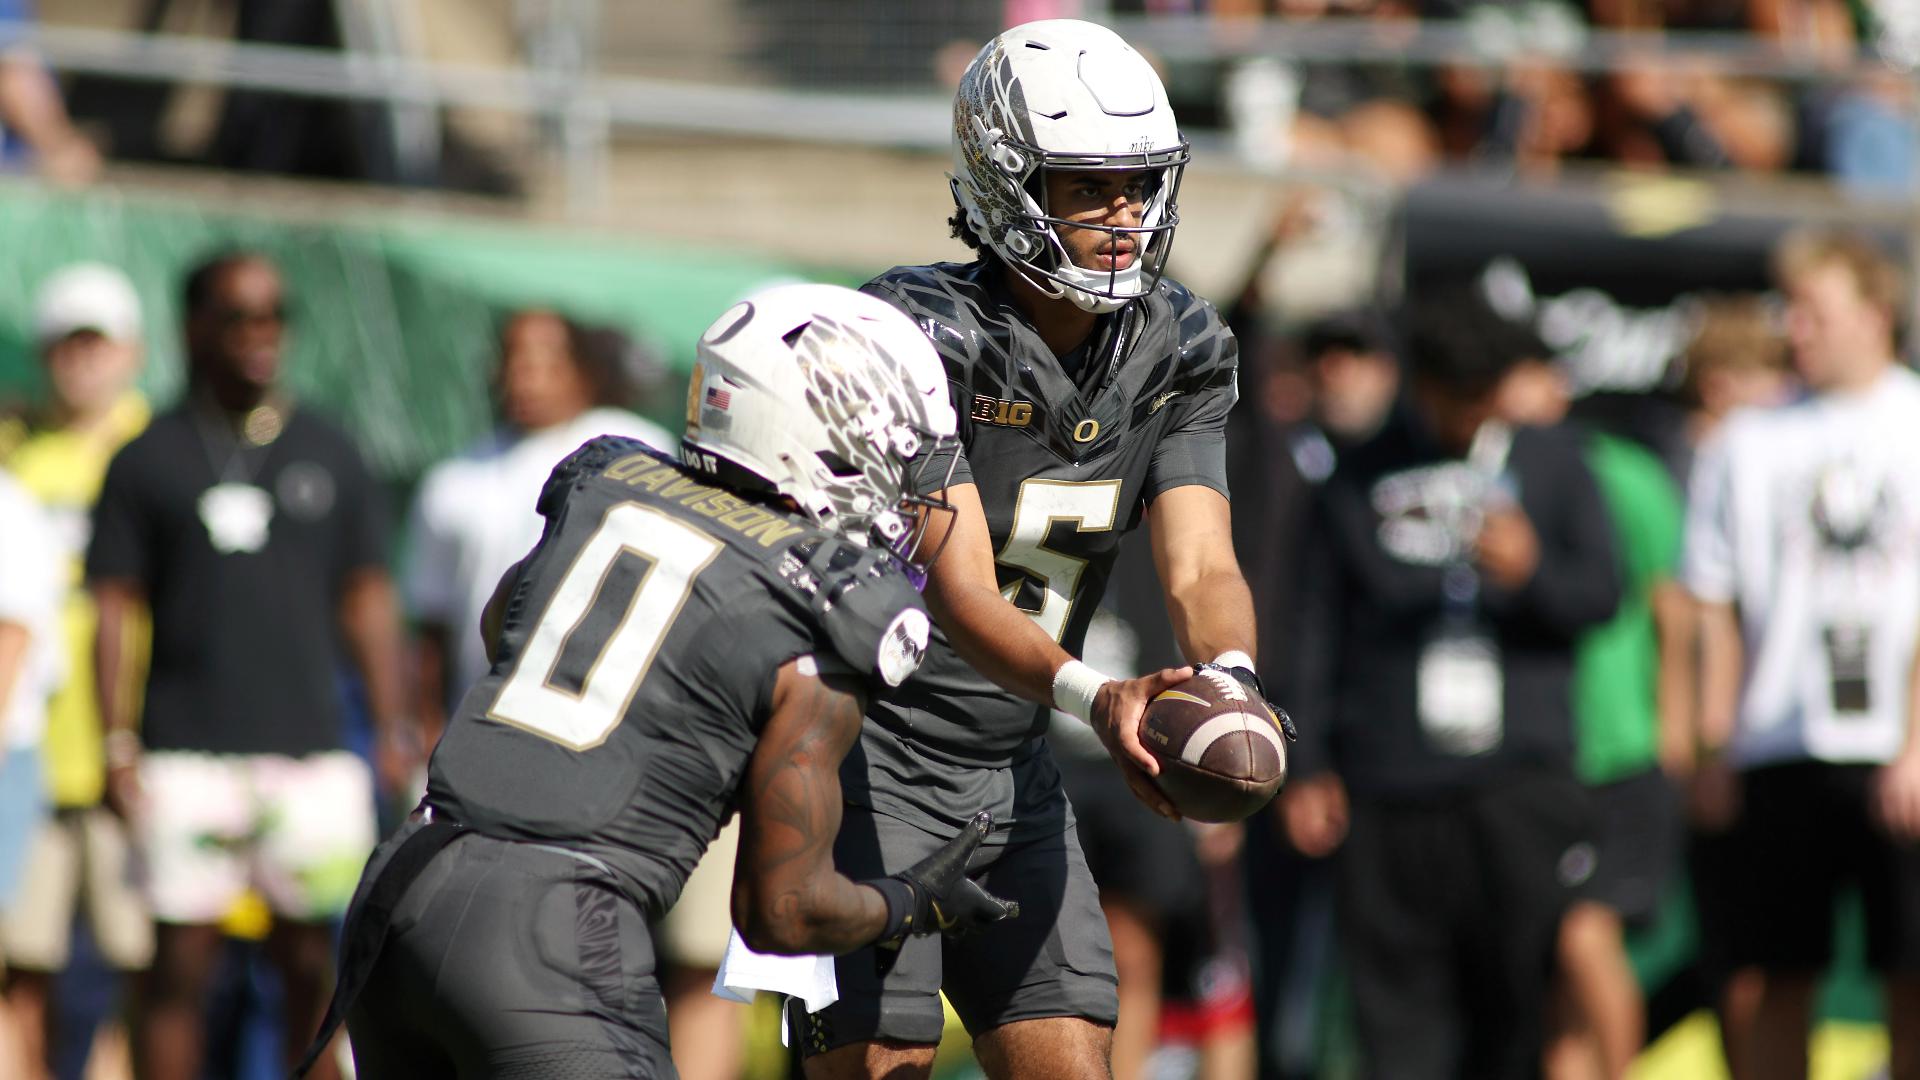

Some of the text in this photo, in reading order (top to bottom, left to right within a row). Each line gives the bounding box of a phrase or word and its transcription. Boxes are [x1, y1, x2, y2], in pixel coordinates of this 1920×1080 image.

[1073, 419, 1099, 442] O
[603, 453, 804, 547] DAVISON
[996, 478, 1123, 645] 5
